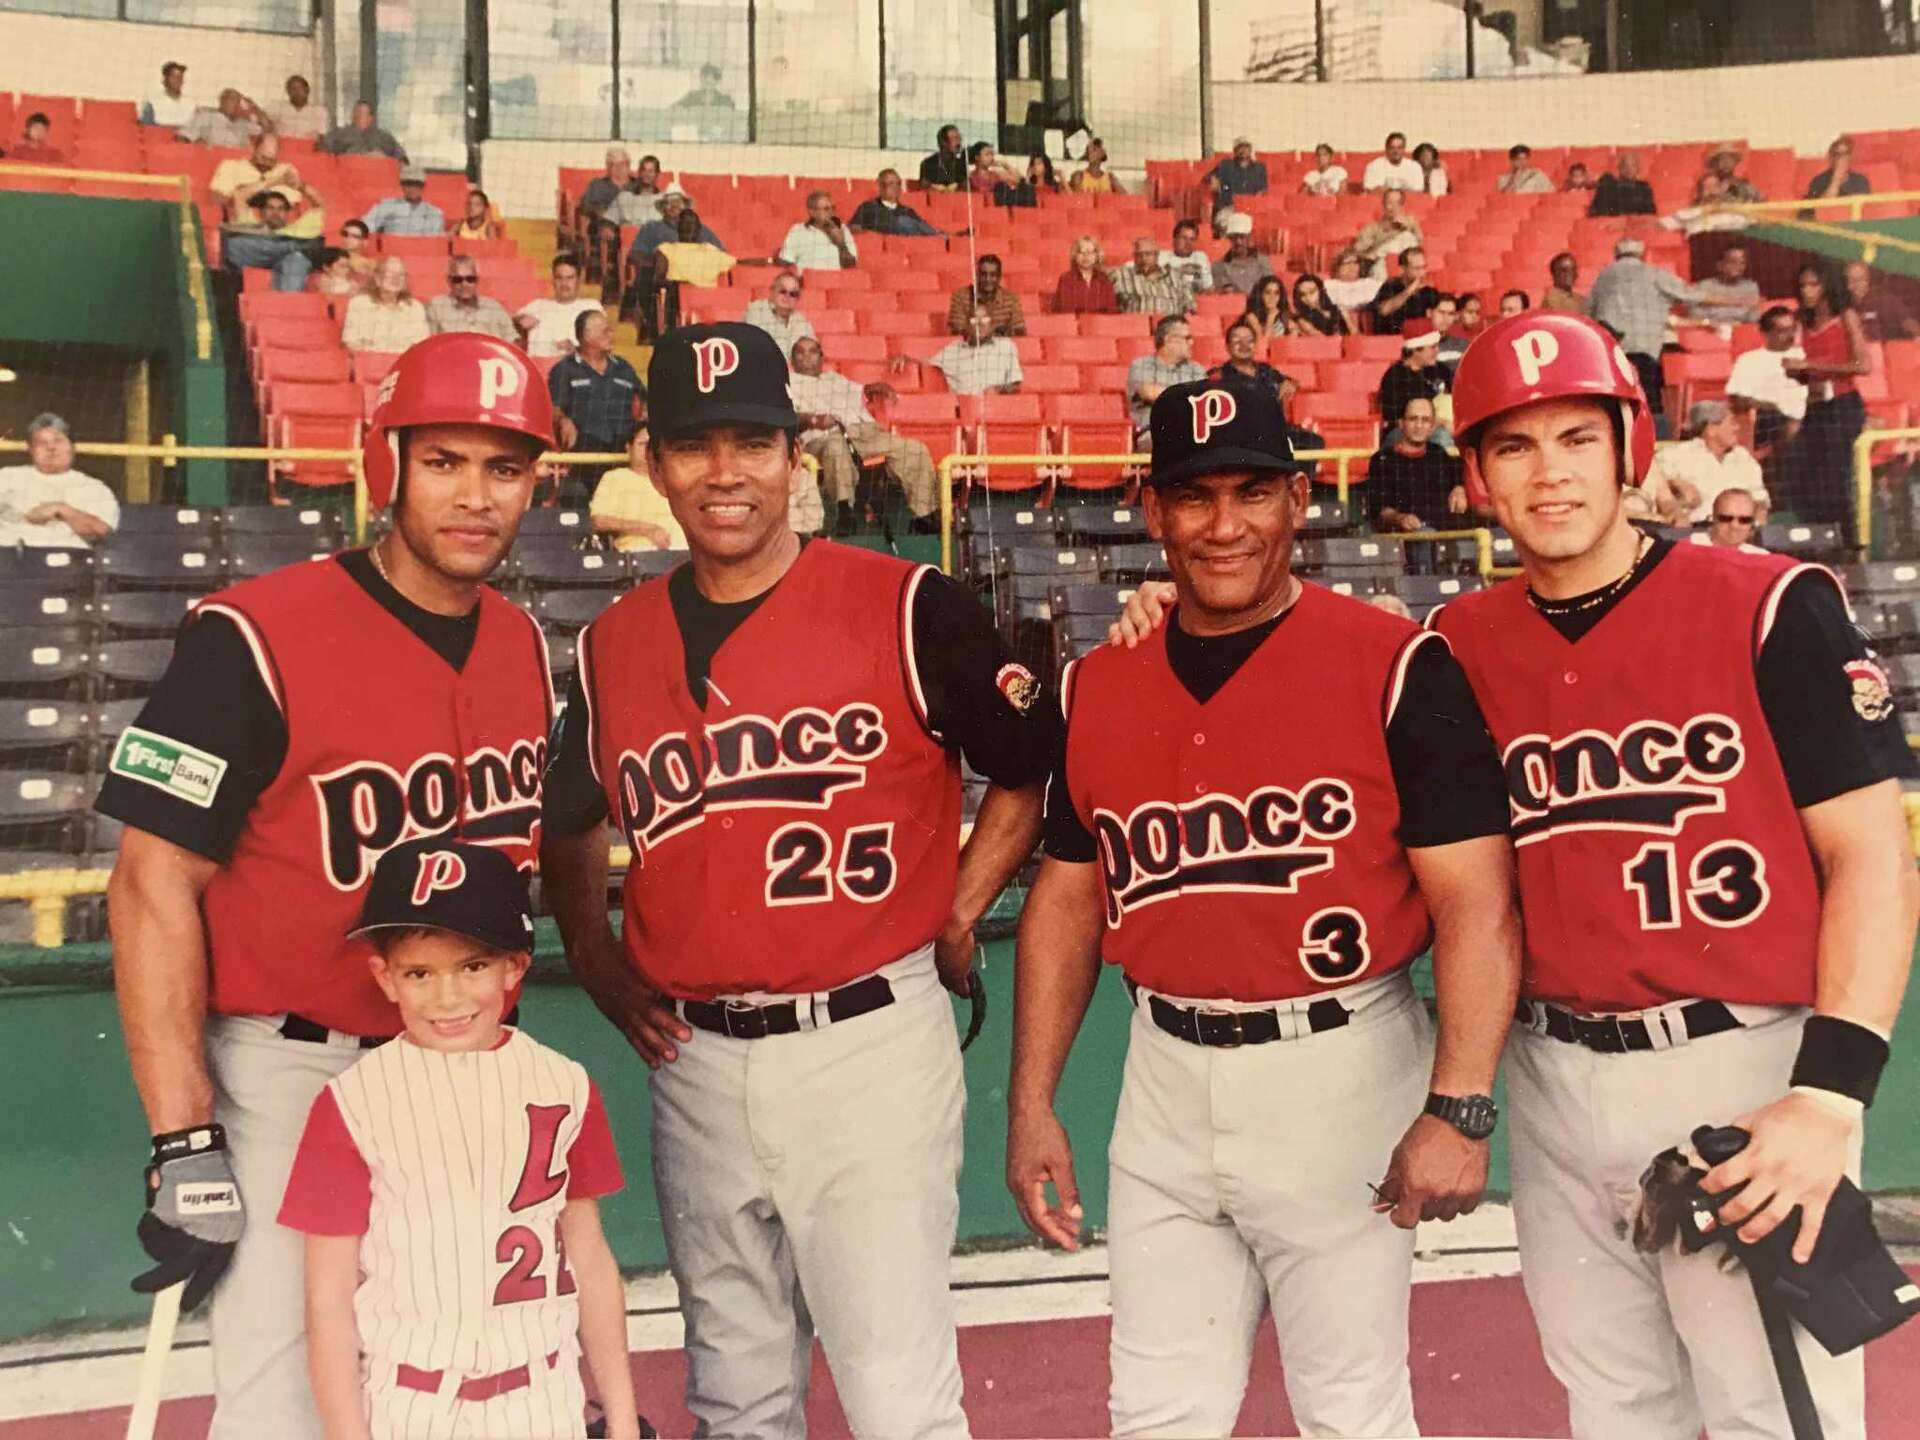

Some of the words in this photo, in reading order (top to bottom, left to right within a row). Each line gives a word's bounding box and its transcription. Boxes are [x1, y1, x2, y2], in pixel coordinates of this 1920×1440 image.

[175, 764, 211, 787] Bank
[765, 821, 897, 907] 25
[1622, 839, 1770, 931] 13
[1298, 906, 1371, 983] 3
[508, 1103, 571, 1213] L
